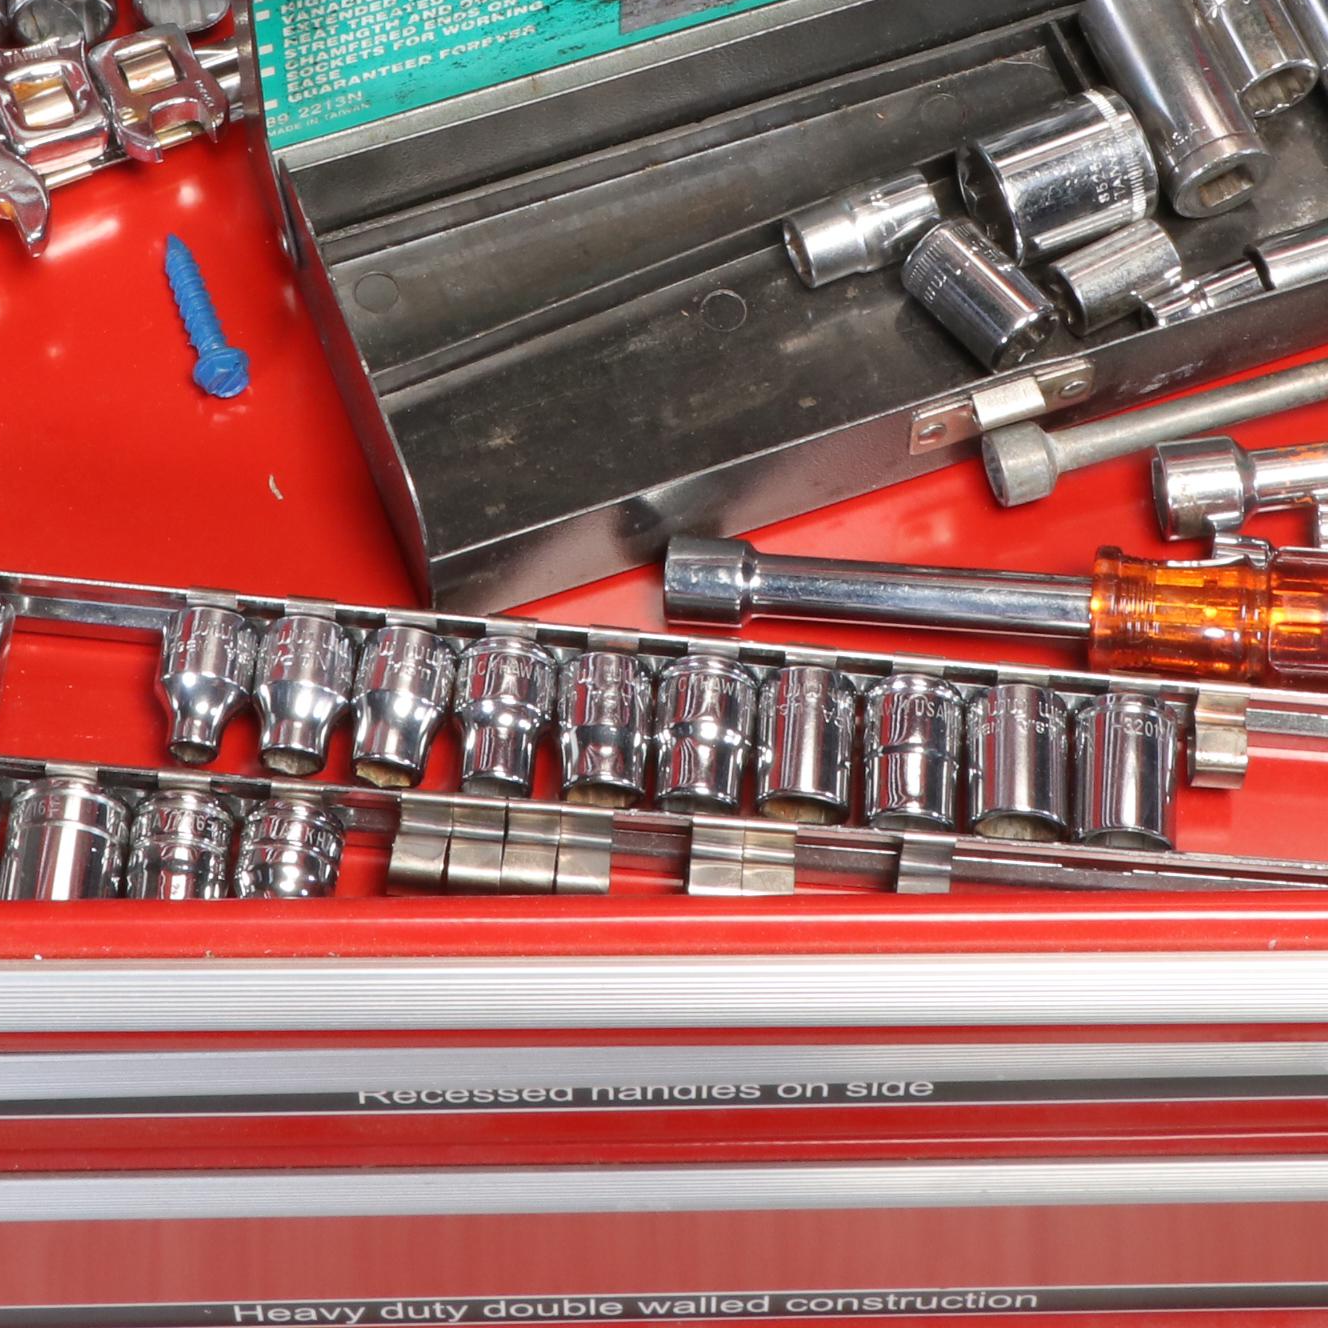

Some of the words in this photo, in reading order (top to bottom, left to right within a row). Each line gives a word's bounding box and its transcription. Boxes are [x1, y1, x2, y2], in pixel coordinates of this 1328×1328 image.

[284, 20, 400, 59] STRENGTH
[409, 4, 453, 25] AND
[284, 25, 340, 48] HEAT
[285, 26, 417, 70] CHAMFERED
[425, 7, 480, 30] ENDS
[286, 45, 386, 82] SOCKETS
[393, 32, 435, 51] FOR
[443, 0, 544, 36] WORKING
[287, 54, 433, 103] GUARANTEED
[439, 24, 537, 60] FOREVER
[287, 69, 342, 93] EASE
[299, 90, 363, 119] 2213N
[267, 123, 302, 137] MADE
[776, 1082, 829, 1099] on
[233, 1304, 367, 1325] Heavy
[380, 1301, 469, 1322] duty
[483, 1299, 624, 1318] double
[637, 1296, 770, 1315] walled
[785, 1292, 1039, 1313] construction
